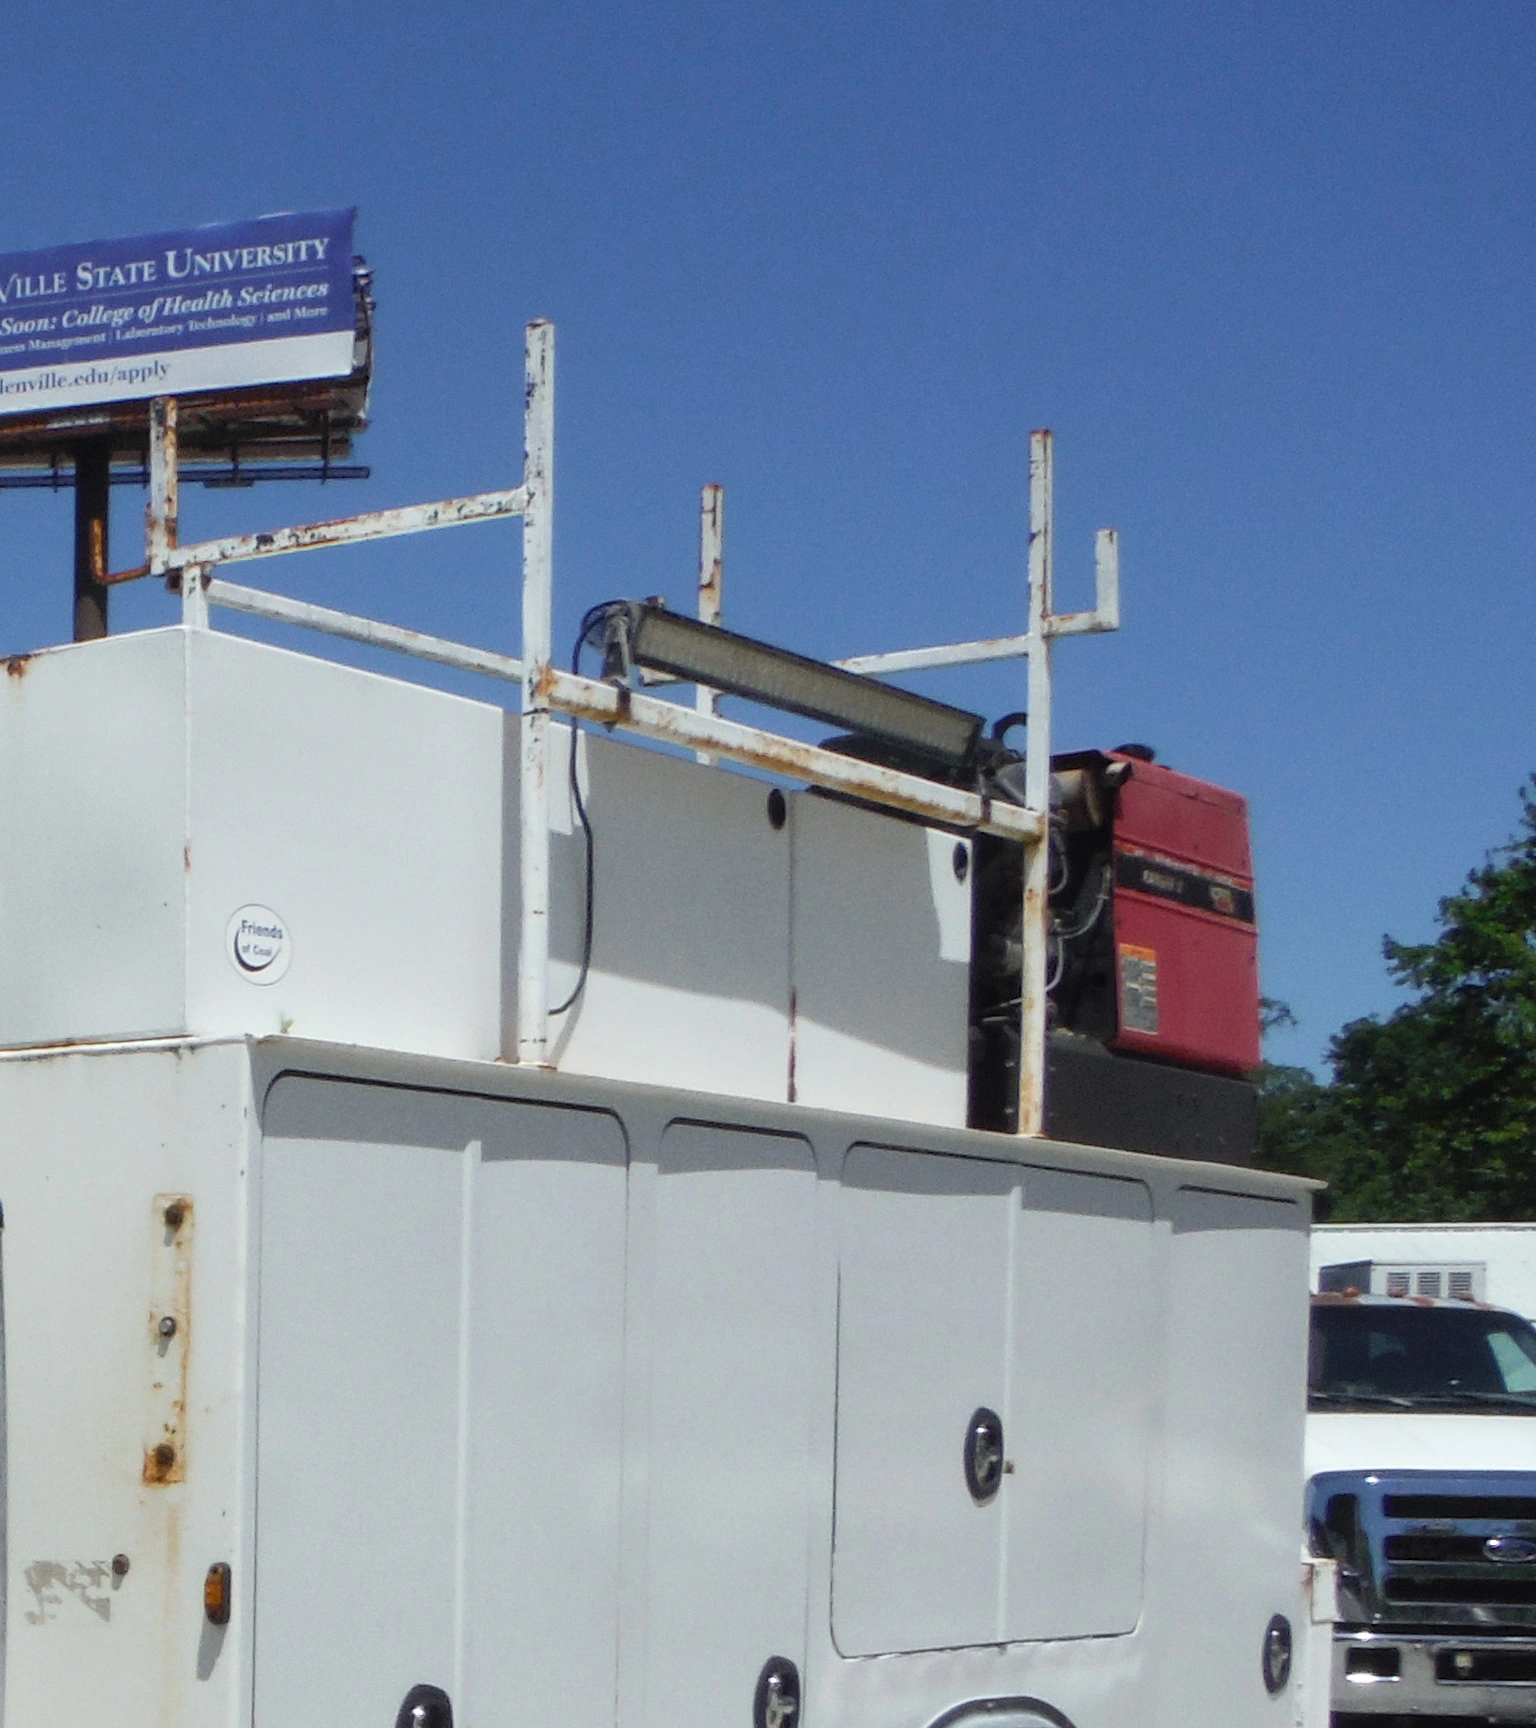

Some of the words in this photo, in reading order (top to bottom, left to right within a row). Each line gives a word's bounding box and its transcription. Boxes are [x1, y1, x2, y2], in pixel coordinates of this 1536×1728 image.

[77, 260, 158, 291] STATE
[165, 238, 329, 277] UNIVERSITY
[63, 304, 134, 328] College
[138, 297, 164, 323] of
[163, 289, 232, 315] Health
[238, 283, 329, 306] Sciences
[241, 920, 283, 939] Friends
